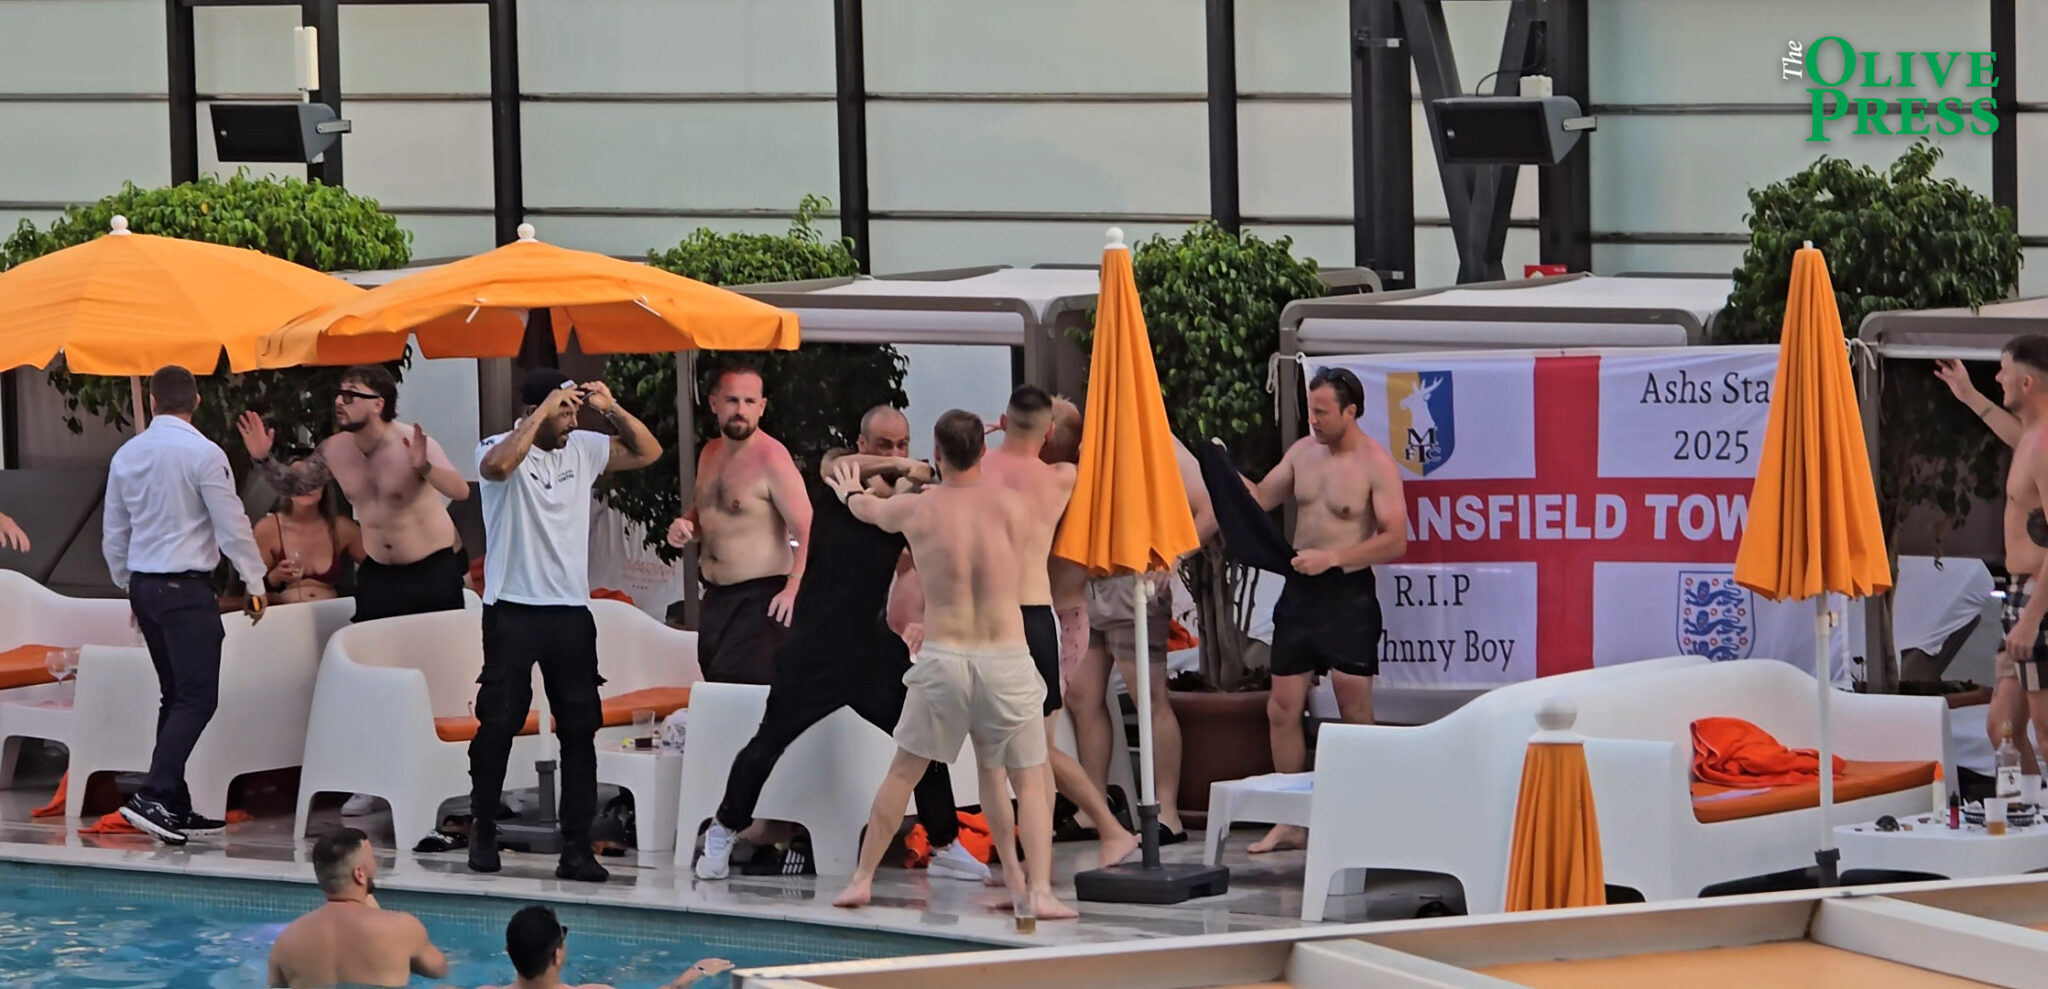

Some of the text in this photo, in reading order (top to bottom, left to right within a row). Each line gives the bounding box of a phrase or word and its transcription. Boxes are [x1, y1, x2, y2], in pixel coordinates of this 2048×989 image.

[1640, 370, 1770, 404] Ashs Sta
[1674, 430, 1749, 464] 2025
[1394, 574, 1471, 607] R.I.P
[1464, 629, 1515, 672] Boy
